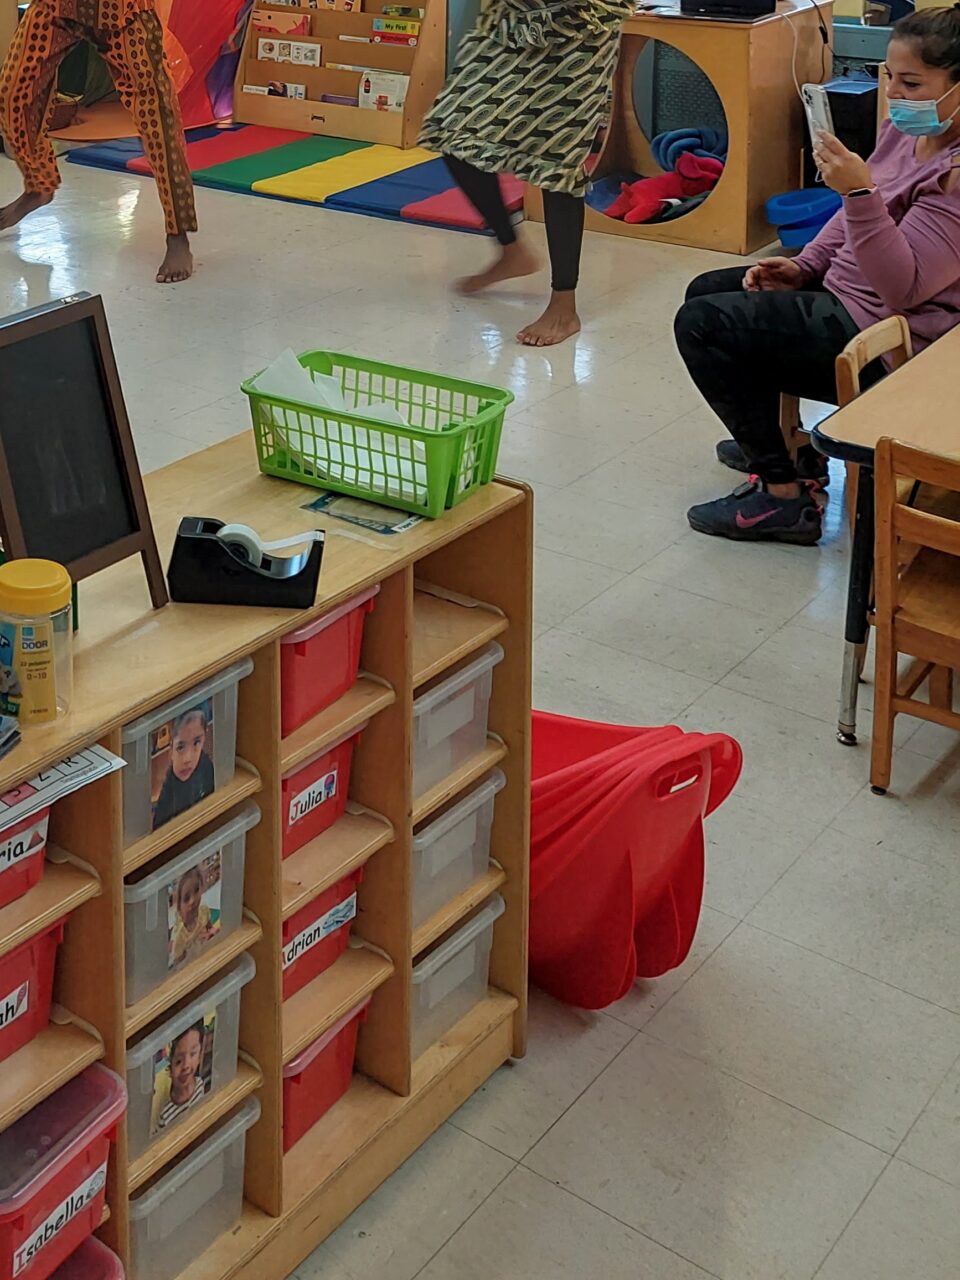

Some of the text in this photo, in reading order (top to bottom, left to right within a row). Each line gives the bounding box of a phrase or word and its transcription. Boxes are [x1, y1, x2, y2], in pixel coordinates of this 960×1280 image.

[385, 23, 394, 31] My
[22, 640, 48, 649] DOOR
[61, 756, 79, 767] R
[291, 790, 323, 820] Julia
[15, 1195, 84, 1275] Isabella
